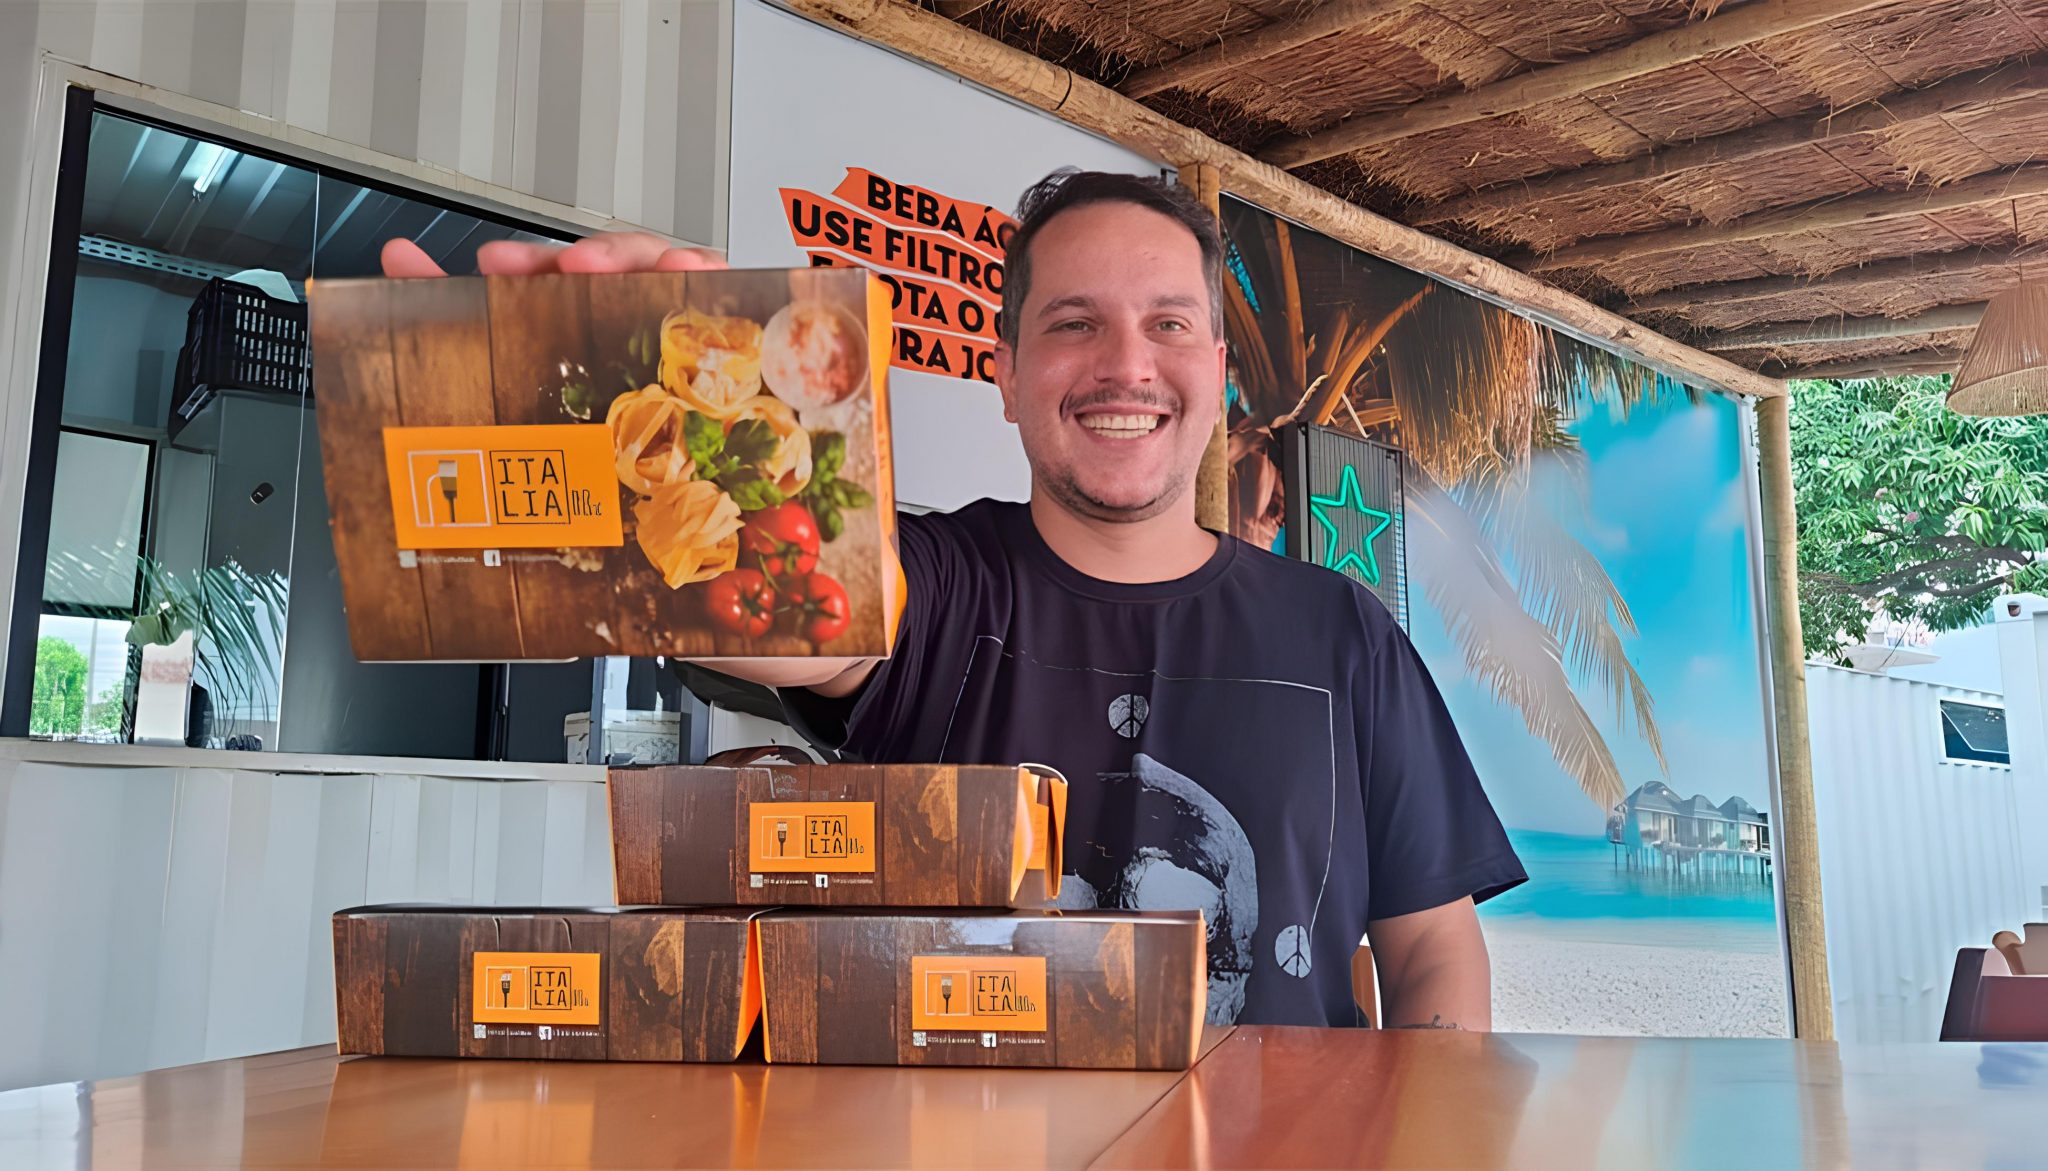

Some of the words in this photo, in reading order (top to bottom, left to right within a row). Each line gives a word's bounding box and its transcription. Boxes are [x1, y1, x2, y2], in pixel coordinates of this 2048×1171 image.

[867, 174, 965, 239] BEBA
[792, 198, 873, 255] USE
[885, 230, 1003, 295] FILTRO
[877, 274, 949, 325] OTA
[958, 300, 984, 333] O
[498, 457, 559, 485] ITA
[502, 489, 563, 517] LIA
[810, 820, 843, 836] ITA
[810, 838, 843, 853] LIA
[534, 971, 567, 987] ITA
[977, 975, 1012, 992] ITA
[534, 989, 567, 1007] LIA
[977, 994, 1013, 1011] LIA
